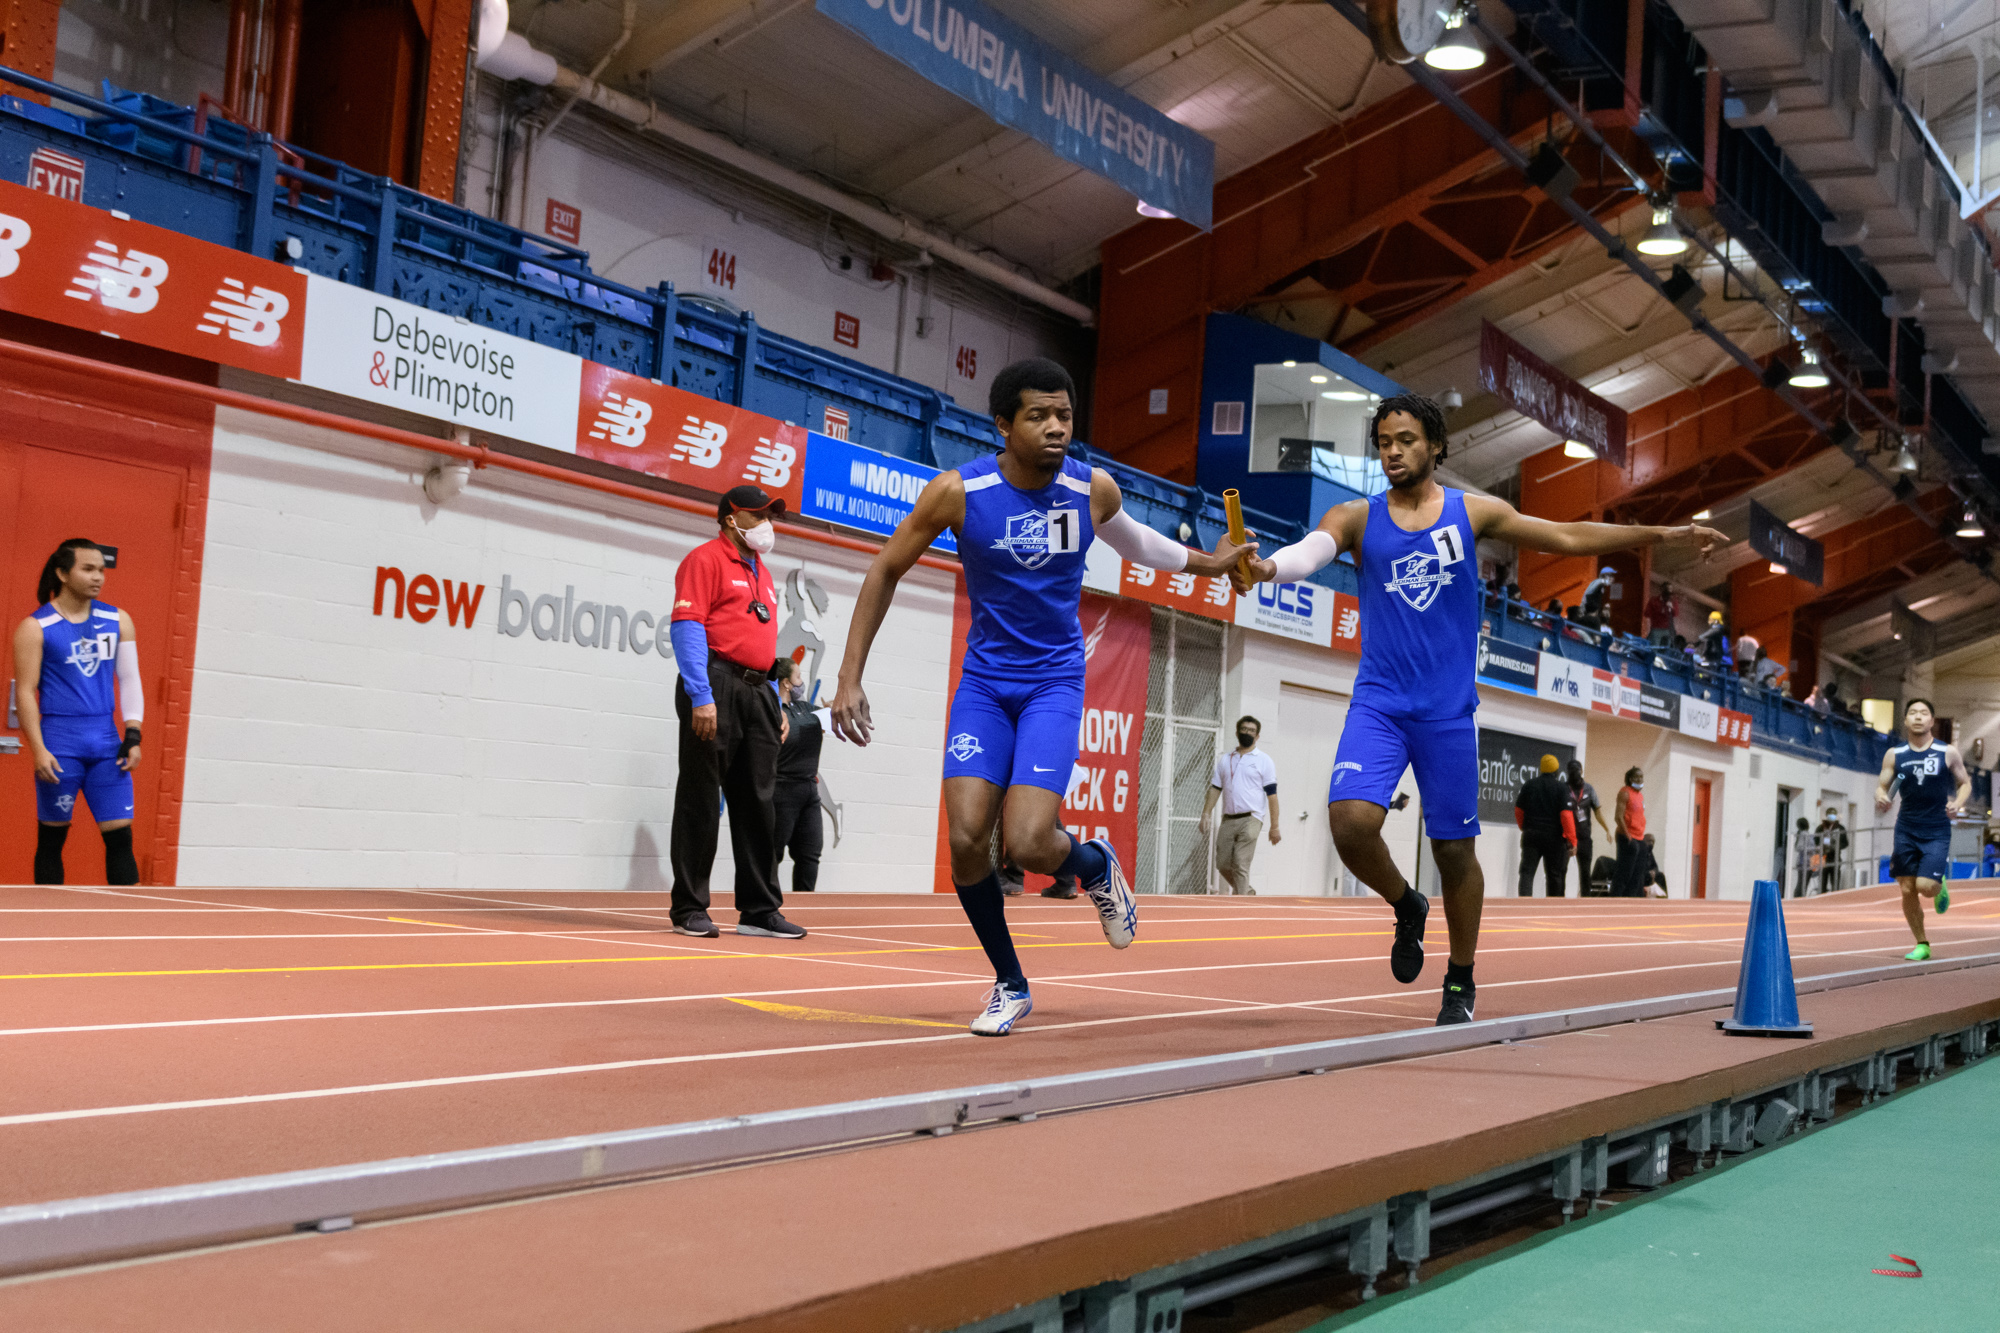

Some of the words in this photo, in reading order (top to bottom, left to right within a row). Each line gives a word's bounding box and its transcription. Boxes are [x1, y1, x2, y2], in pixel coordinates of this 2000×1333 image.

[866, 0, 1025, 99] OLUMBIA
[1041, 66, 1184, 187] UNIVERSITY
[32, 166, 80, 201] EXIT
[553, 207, 575, 229] EXIT
[708, 248, 736, 290] 414
[374, 306, 514, 380] Debevoise
[839, 318, 855, 336] EXIT
[956, 345, 977, 380] 415
[825, 420, 847, 442] EXIT
[1053, 513, 1069, 550] 1
[1438, 530, 1457, 562] 1
[1408, 582, 1430, 590] TRACK
[1420, 573, 1447, 583] COLLEGE
[373, 566, 486, 629] new
[497, 574, 675, 659] balance
[1258, 581, 1314, 618] UCS
[102, 635, 111, 658] 1
[1489, 653, 1536, 676] MARINES.COM
[1926, 759, 1936, 773] 3
